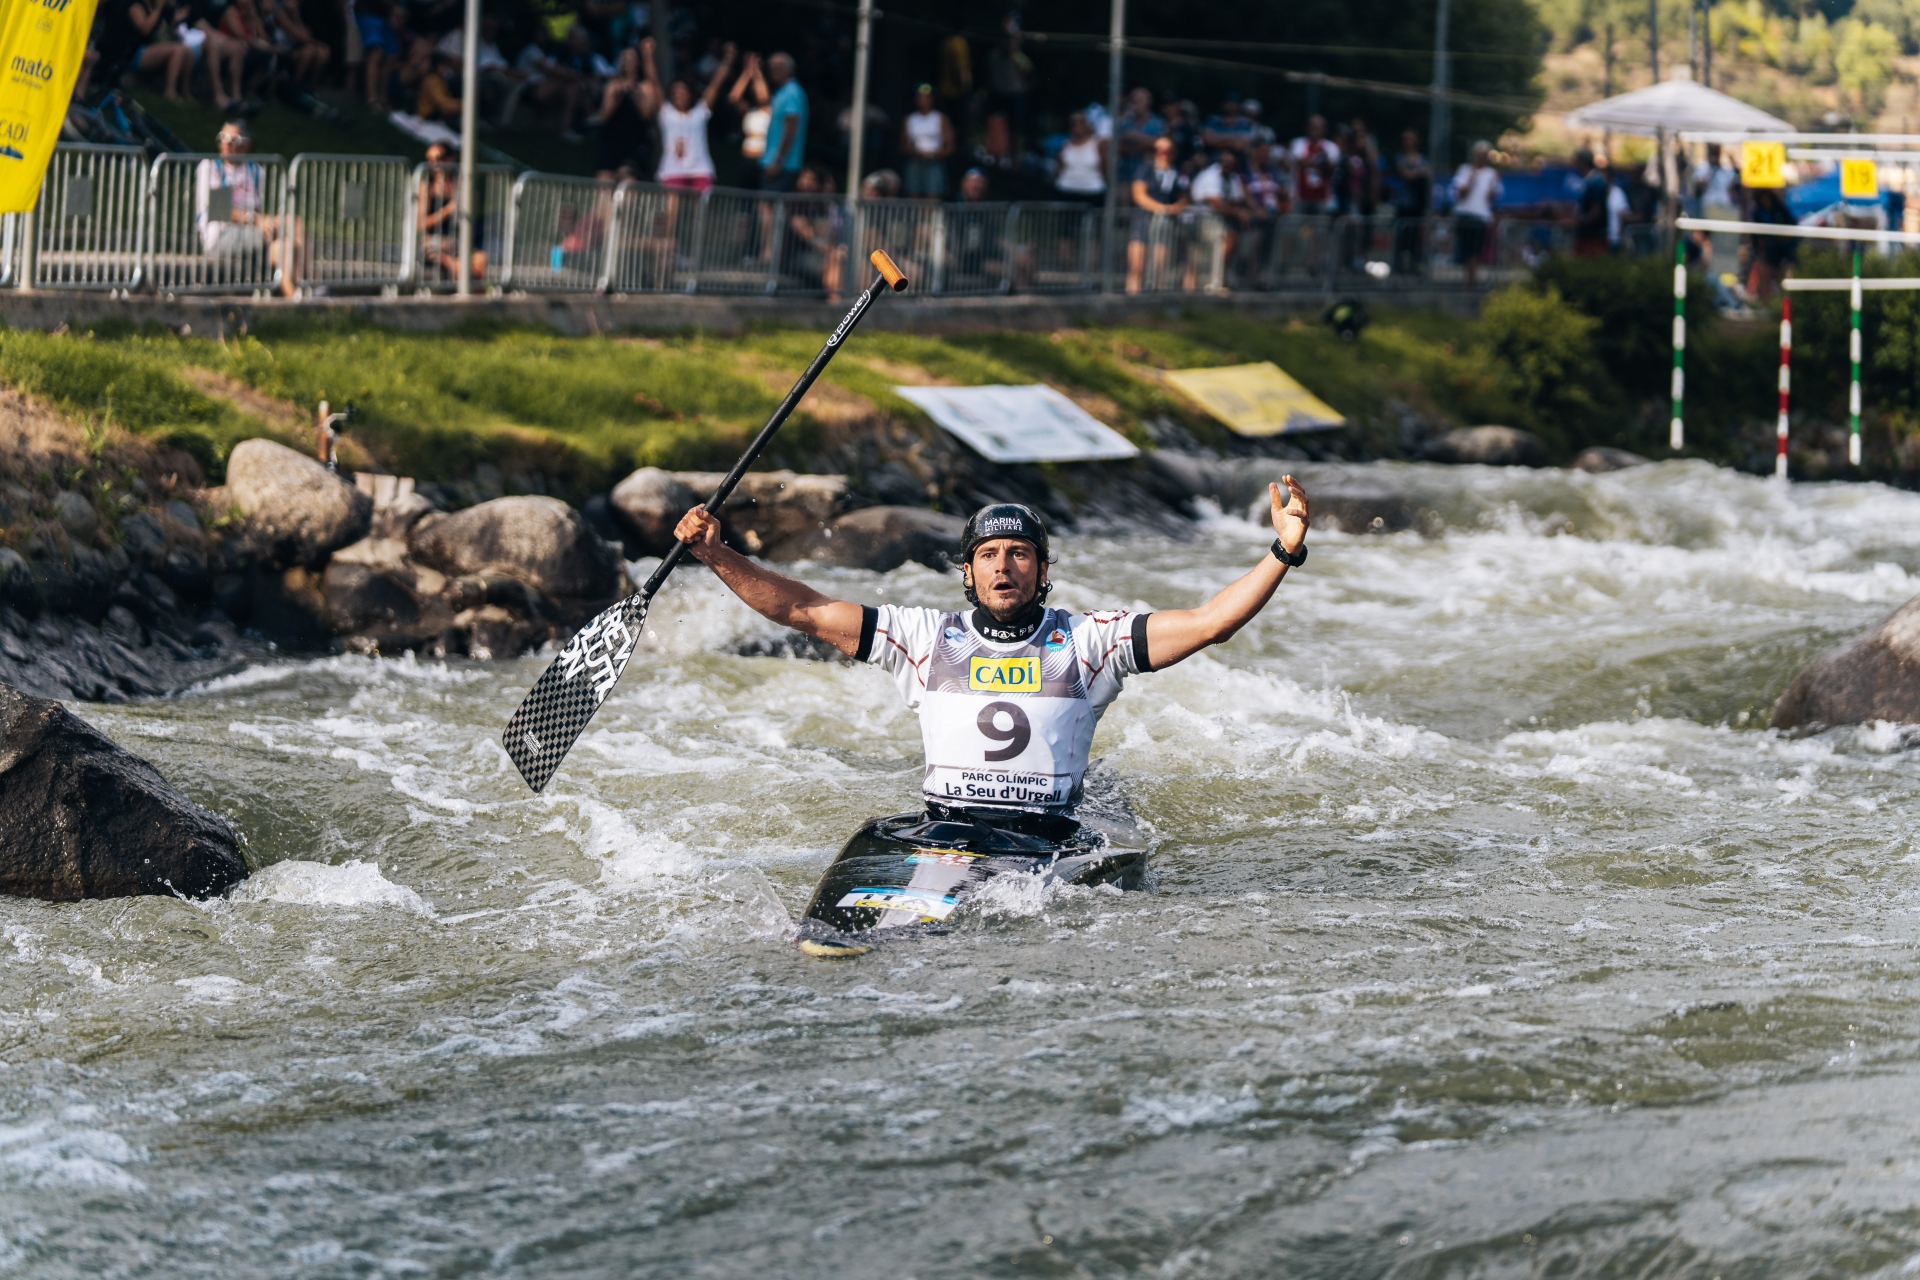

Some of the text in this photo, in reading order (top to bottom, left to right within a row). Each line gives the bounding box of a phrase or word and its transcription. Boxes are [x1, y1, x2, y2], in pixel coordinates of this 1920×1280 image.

[11, 56, 53, 81] mató
[984, 517, 1023, 526] MARINA
[975, 661, 1034, 685] CADÍ
[976, 701, 1031, 762] 9
[962, 772, 1048, 787] PARC OLÍMPIC
[945, 782, 1062, 803] La Seu d'Urgell
